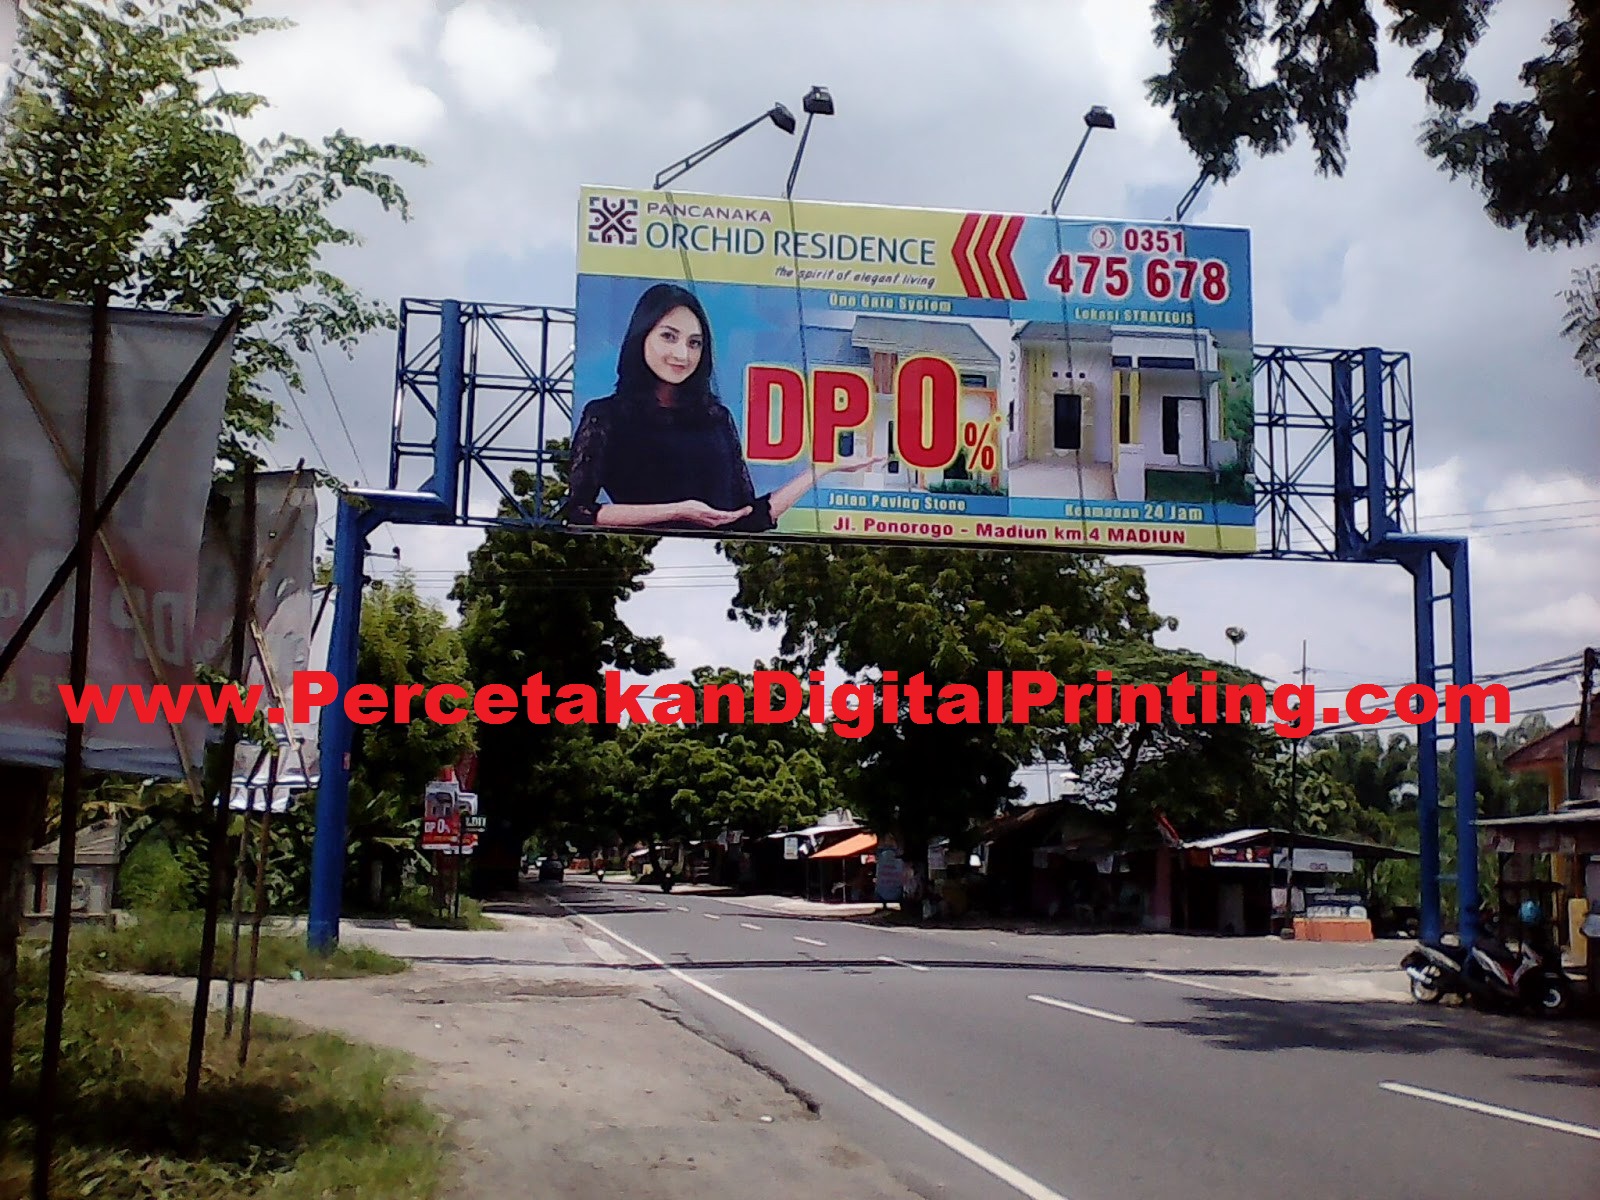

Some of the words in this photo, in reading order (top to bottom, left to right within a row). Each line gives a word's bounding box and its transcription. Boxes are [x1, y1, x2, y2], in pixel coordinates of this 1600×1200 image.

[647, 202, 771, 222] PANCANAKA
[646, 221, 765, 255] ORCHID
[774, 231, 936, 265] RESIDENCE
[1124, 228, 1183, 252] 0351
[775, 266, 796, 277] the
[799, 268, 834, 281] spirit
[837, 270, 851, 281] of
[853, 271, 899, 286] elegant
[902, 274, 936, 289] living
[1048, 254, 1129, 296] 475
[1146, 258, 1226, 301] 678
[829, 292, 856, 307] One
[861, 293, 894, 309] Gate
[899, 296, 953, 313] System
[1124, 309, 1194, 325] STRATEGIS
[746, 365, 870, 464] DP
[829, 492, 867, 507] Jalan
[871, 494, 920, 511] Paving
[924, 496, 967, 512] Stone
[1065, 503, 1140, 519] Keamanan
[1144, 503, 1164, 519] 24
[1169, 504, 1203, 521] Jam
[833, 517, 855, 531] Jl.
[864, 517, 954, 538] Ponorogo
[976, 523, 1048, 540] Madiun
[1108, 528, 1186, 544] MADIUN
